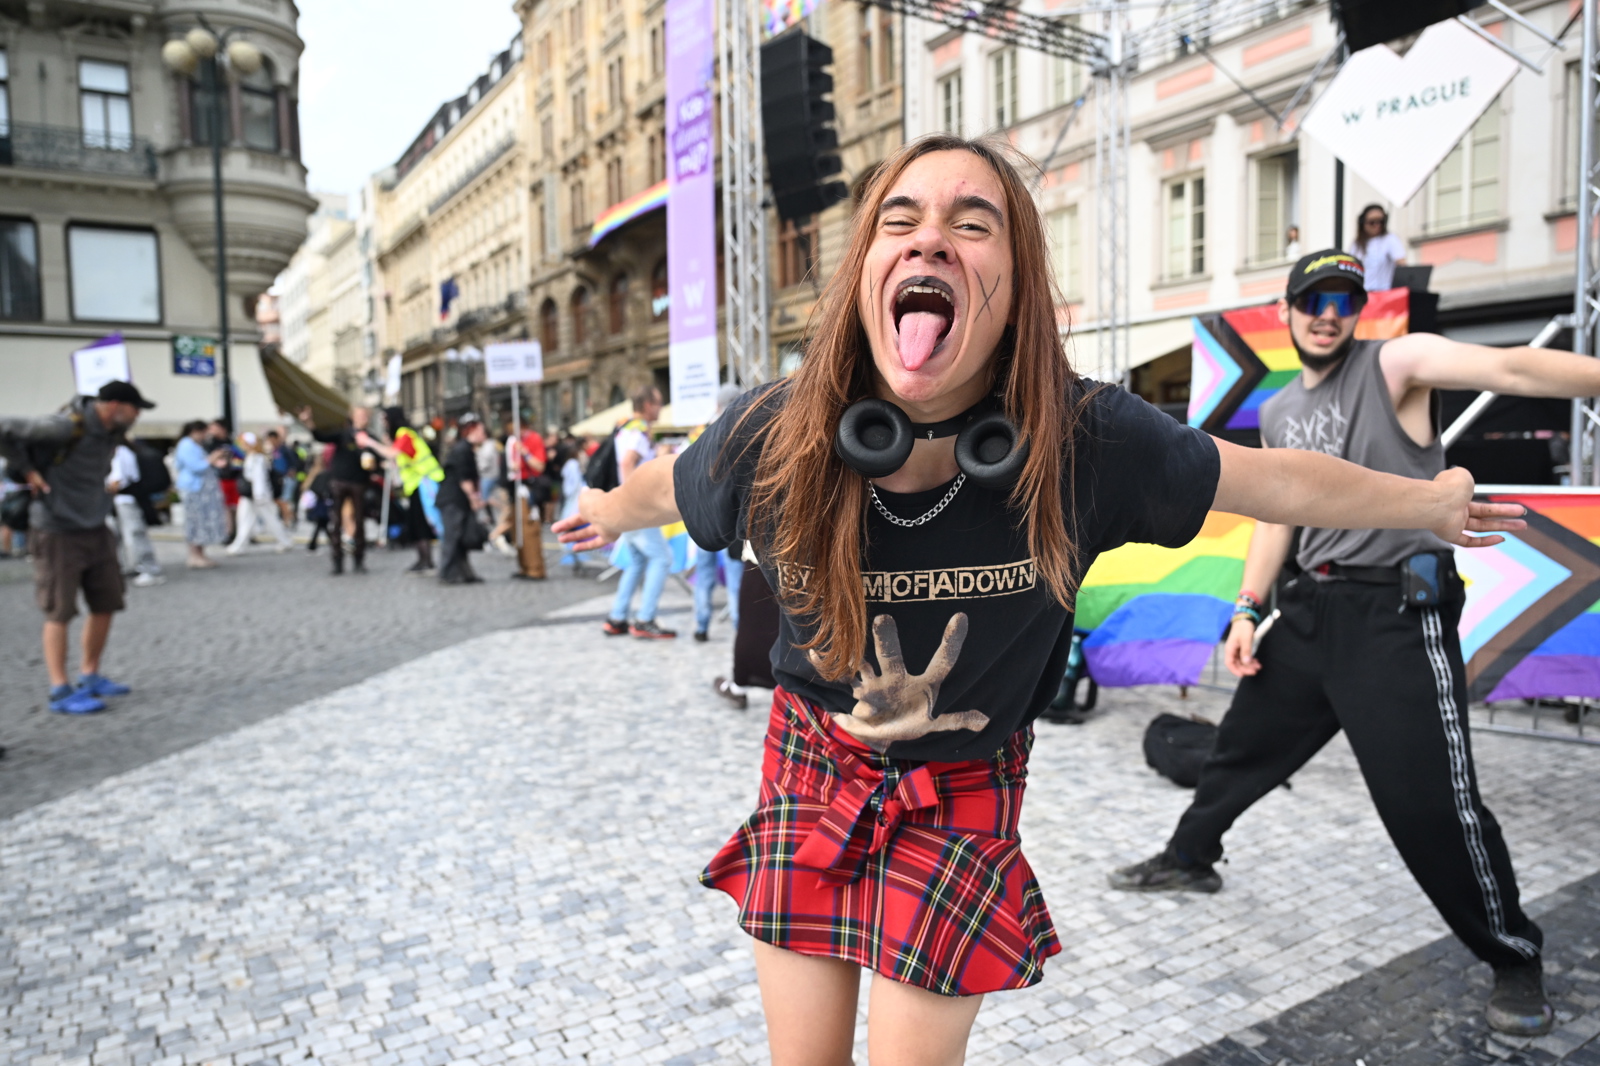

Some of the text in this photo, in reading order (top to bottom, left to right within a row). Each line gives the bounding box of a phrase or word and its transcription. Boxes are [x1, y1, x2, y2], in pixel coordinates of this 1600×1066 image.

[1342, 75, 1471, 125] W PRAGUE
[892, 574, 929, 597] OF
[934, 571, 955, 595] A
[958, 562, 1035, 594] DOWN
